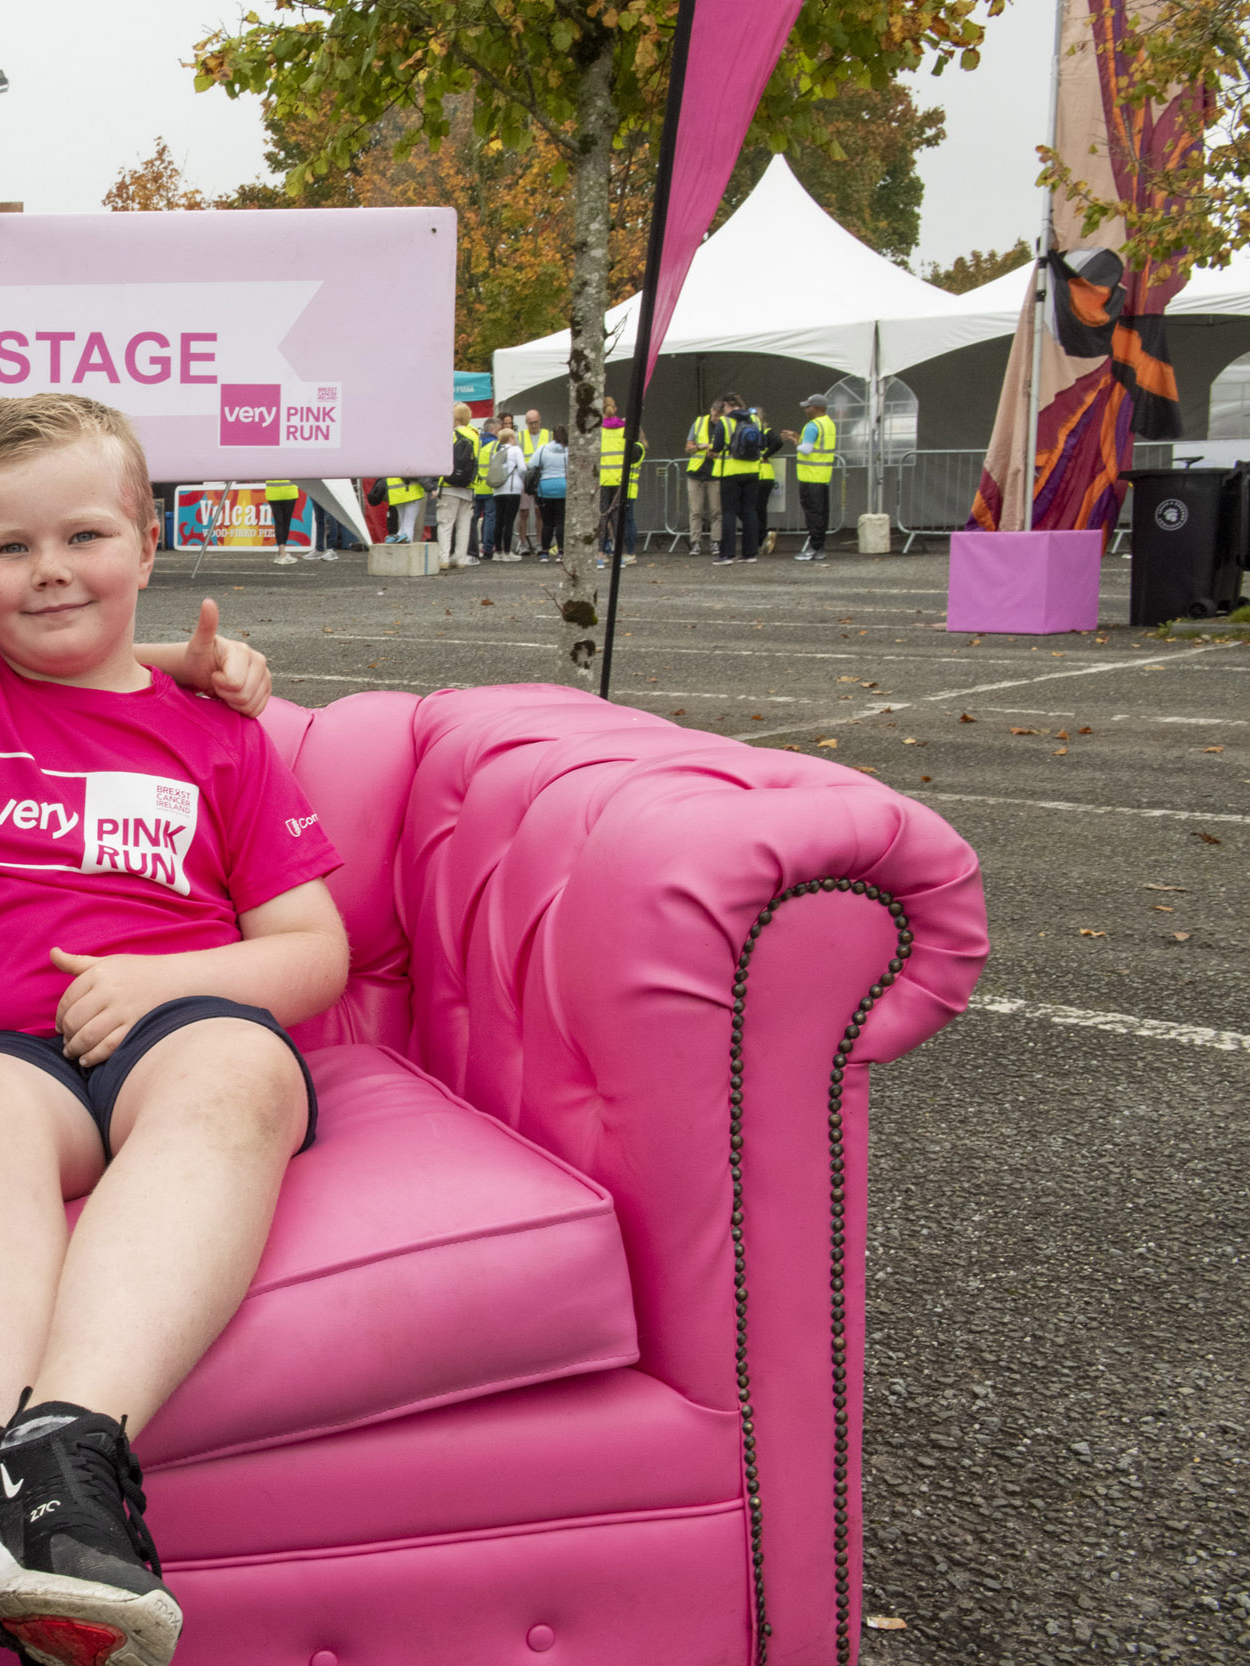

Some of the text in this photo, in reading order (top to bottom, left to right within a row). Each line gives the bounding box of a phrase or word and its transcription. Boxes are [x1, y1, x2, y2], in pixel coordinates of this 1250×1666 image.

[223, 406, 277, 427] very
[286, 406, 336, 423] PINK
[286, 424, 330, 441] RUN
[200, 500, 273, 526] Volcan
[156, 793, 190, 807] CANCER
[97, 818, 186, 855] PINK
[96, 844, 176, 885] RUN
